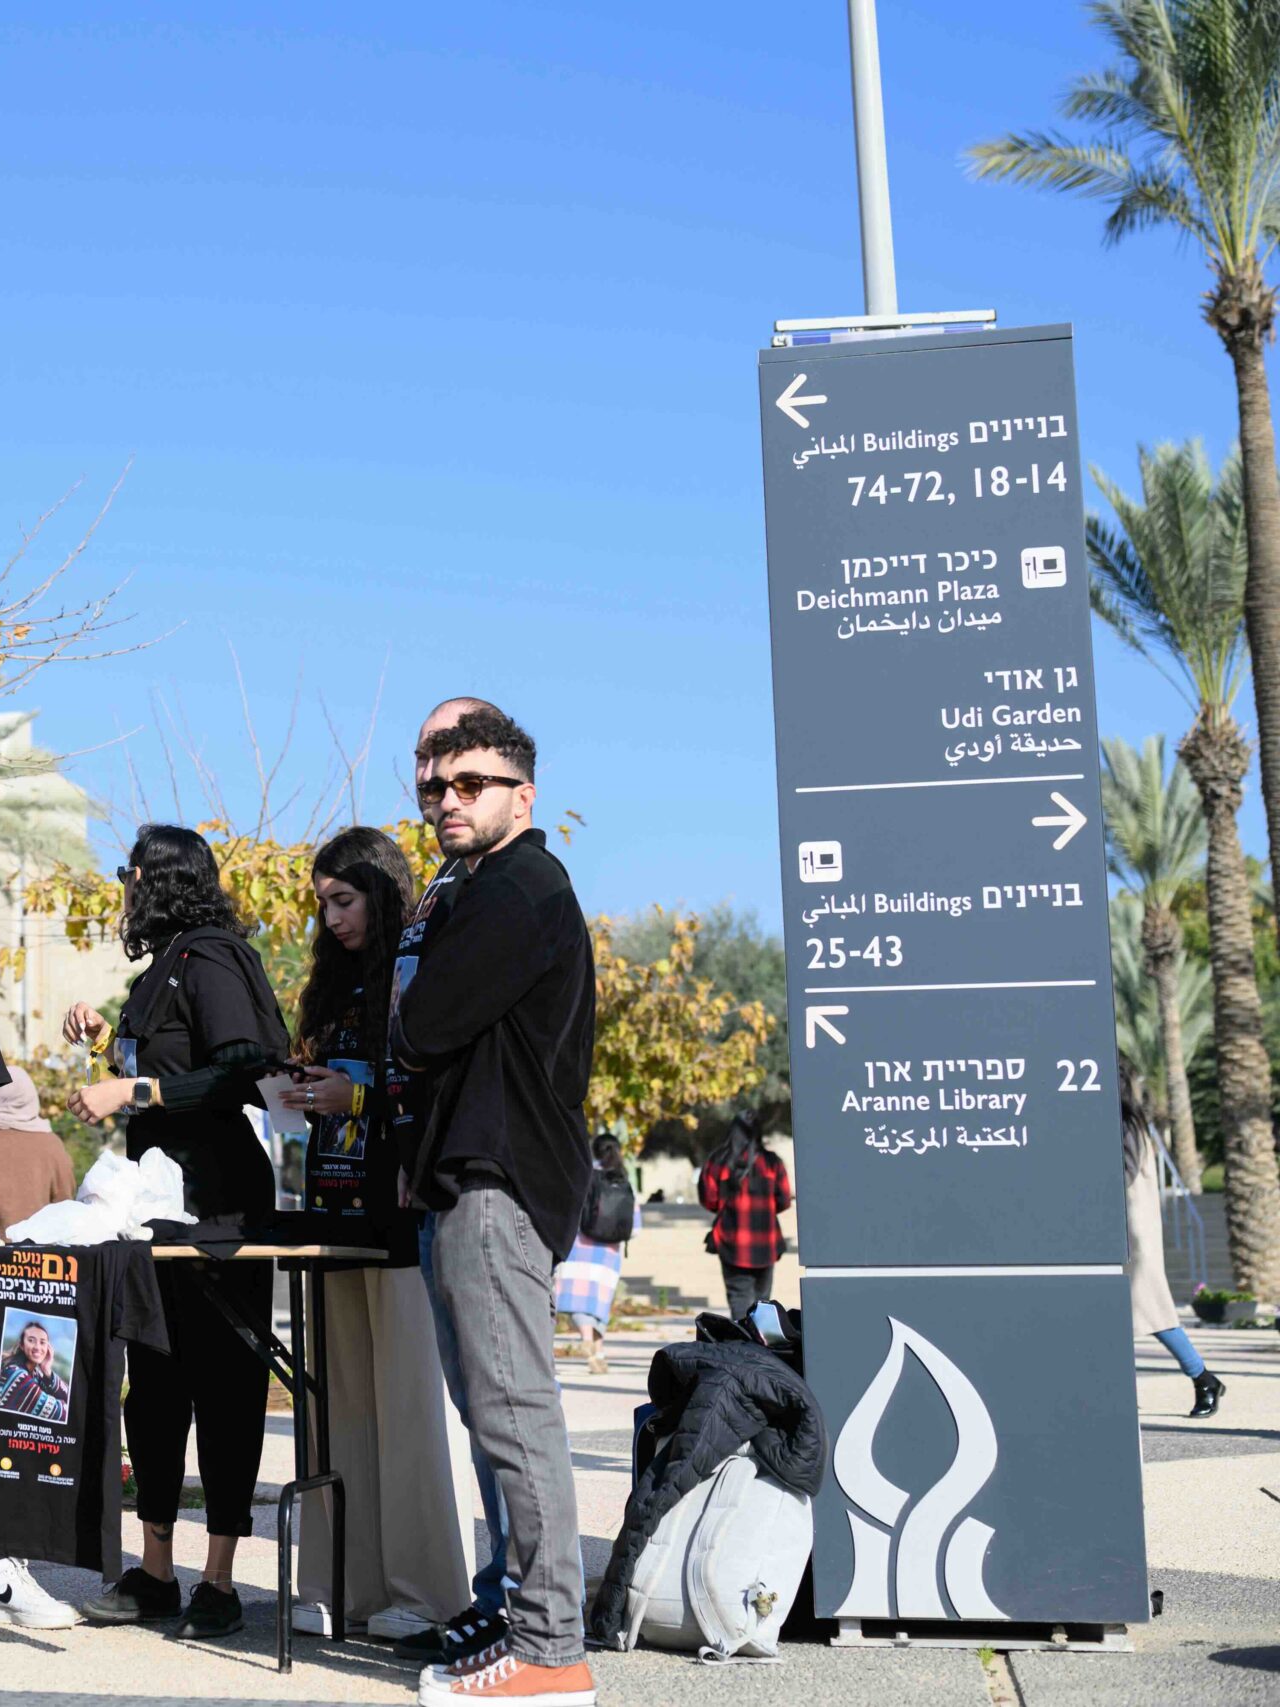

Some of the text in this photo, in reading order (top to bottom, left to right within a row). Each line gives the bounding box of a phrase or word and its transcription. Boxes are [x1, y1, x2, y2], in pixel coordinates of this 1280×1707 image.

[863, 429, 959, 453] Buildings
[969, 414, 1068, 444] בניינים
[847, 460, 1068, 507] 74-72, 18-14
[840, 549, 998, 585] כיכר דייכמן
[796, 580, 1000, 611] Deichmann Plaza
[837, 607, 1002, 640] ميدان دايخمان
[983, 666, 1078, 694] גן אודי
[941, 702, 1082, 729] Udi Garden
[944, 732, 1082, 767] حديقة أودي
[874, 891, 972, 917] Buildings
[982, 883, 1084, 909] בניינים
[806, 935, 903, 970] 25-43
[864, 1058, 1026, 1089] ספריית ארן
[1056, 1058, 1101, 1092] 22
[841, 1087, 1027, 1116] Aranne Library
[955, 1125, 1028, 1153] المكتبة
[13, 1251, 40, 1264] נועה
[42, 1253, 78, 1282] גם
[38, 1442, 60, 1454] עדיין
